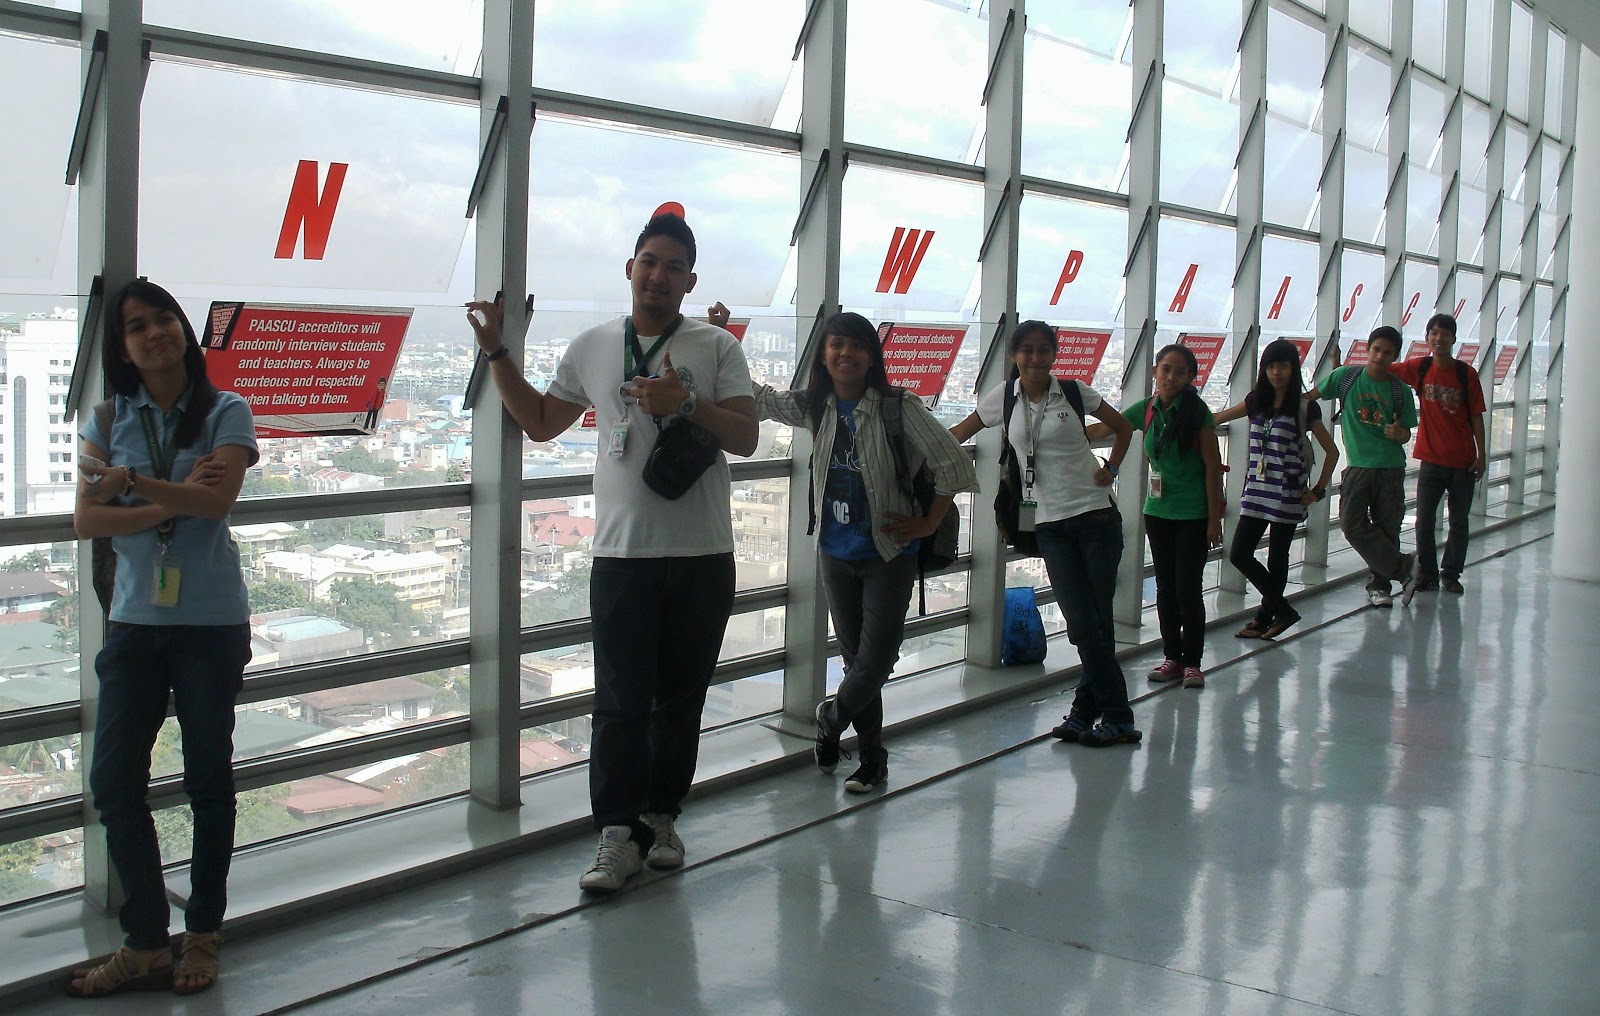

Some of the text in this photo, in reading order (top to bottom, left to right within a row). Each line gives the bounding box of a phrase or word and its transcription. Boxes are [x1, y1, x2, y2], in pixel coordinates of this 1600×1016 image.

[273, 159, 349, 260] N
[875, 226, 935, 294] W
[1049, 250, 1084, 306] P
[1168, 264, 1199, 313] A
[1267, 276, 1292, 319] A
[1342, 283, 1364, 323] S
[1402, 291, 1421, 327] C
[249, 319, 295, 332] PAASCU
[298, 321, 358, 334] accreditors
[361, 322, 381, 334] will
[890, 332, 919, 344] Teachers
[918, 333, 931, 344] and
[930, 334, 955, 344] students
[231, 338, 386, 353] randomly interview students
[883, 349, 952, 361] are strongly encouraged
[238, 356, 370, 370] and teachers. Always be
[887, 364, 910, 374] borrow
[909, 364, 928, 374] books
[927, 363, 942, 374] from
[233, 374, 365, 389] courteous and respectful
[243, 393, 349, 407] when talking to them.
